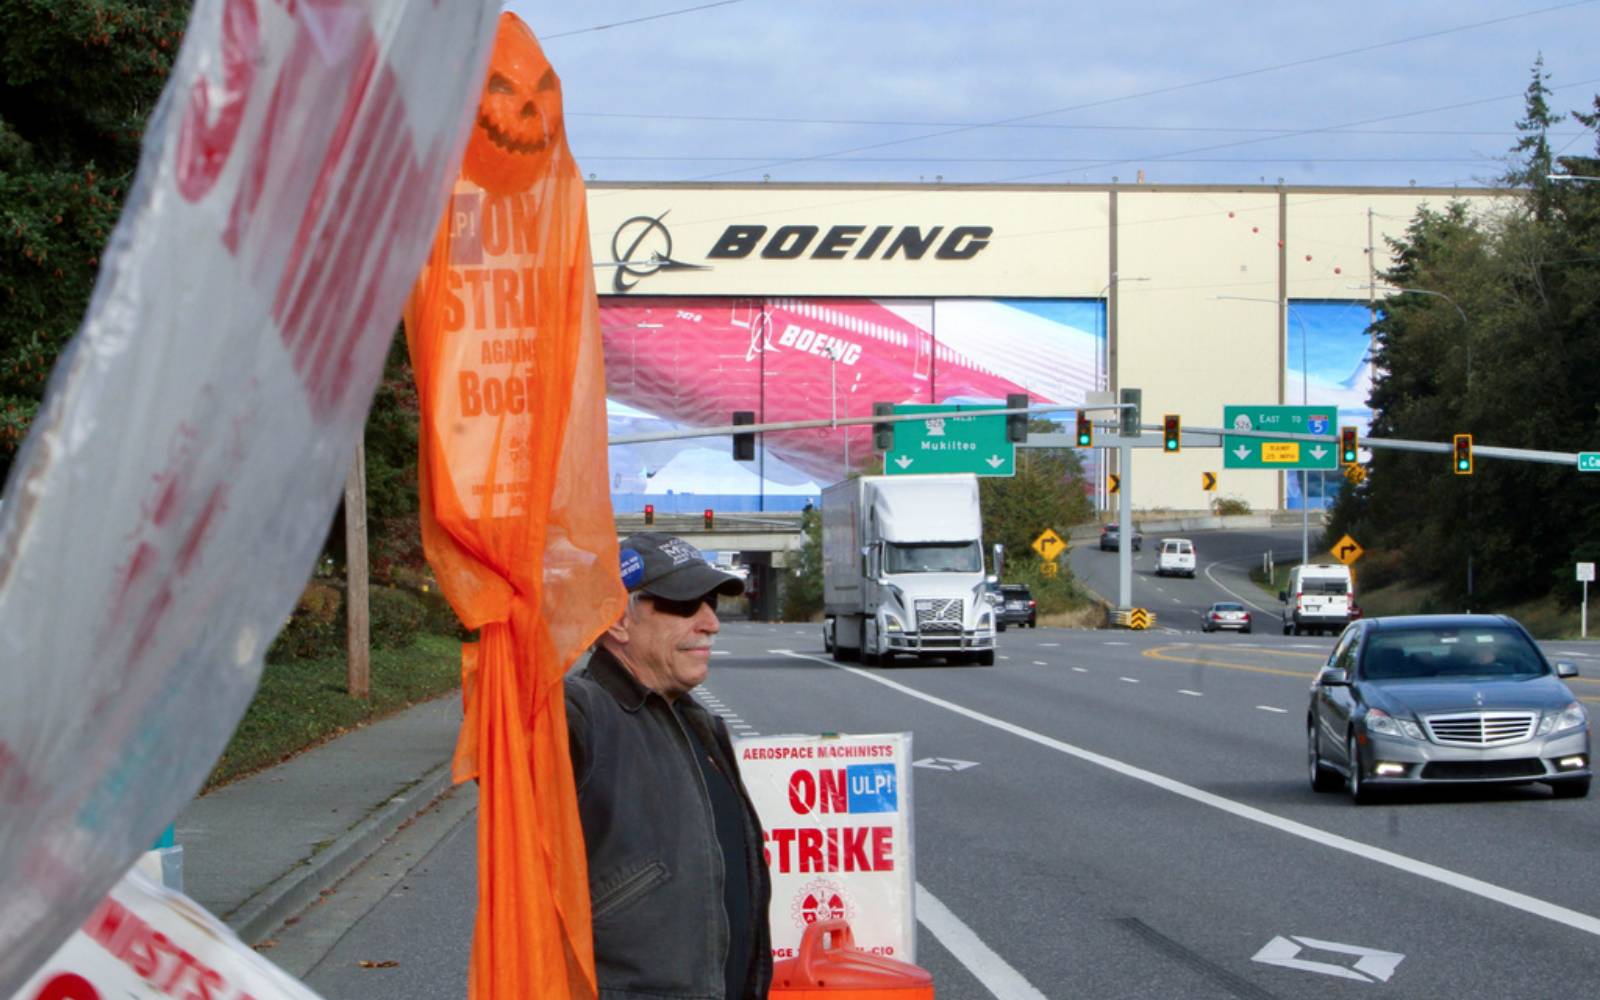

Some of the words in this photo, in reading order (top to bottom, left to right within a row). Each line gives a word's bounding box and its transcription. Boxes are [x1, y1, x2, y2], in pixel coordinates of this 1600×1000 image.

[481, 194, 540, 257] ON
[705, 225, 994, 260] BOEING
[442, 266, 548, 333] STRI
[778, 324, 863, 366] BOEING
[1259, 414, 1280, 423] EAST
[1291, 415, 1302, 423] TO
[1313, 420, 1323, 432] 5
[921, 440, 976, 450] Mukilteo
[743, 747, 813, 760] AEROSPACE
[817, 745, 893, 759] MACHINISTS
[788, 769, 848, 815] ON
[852, 774, 893, 795] ULP!
